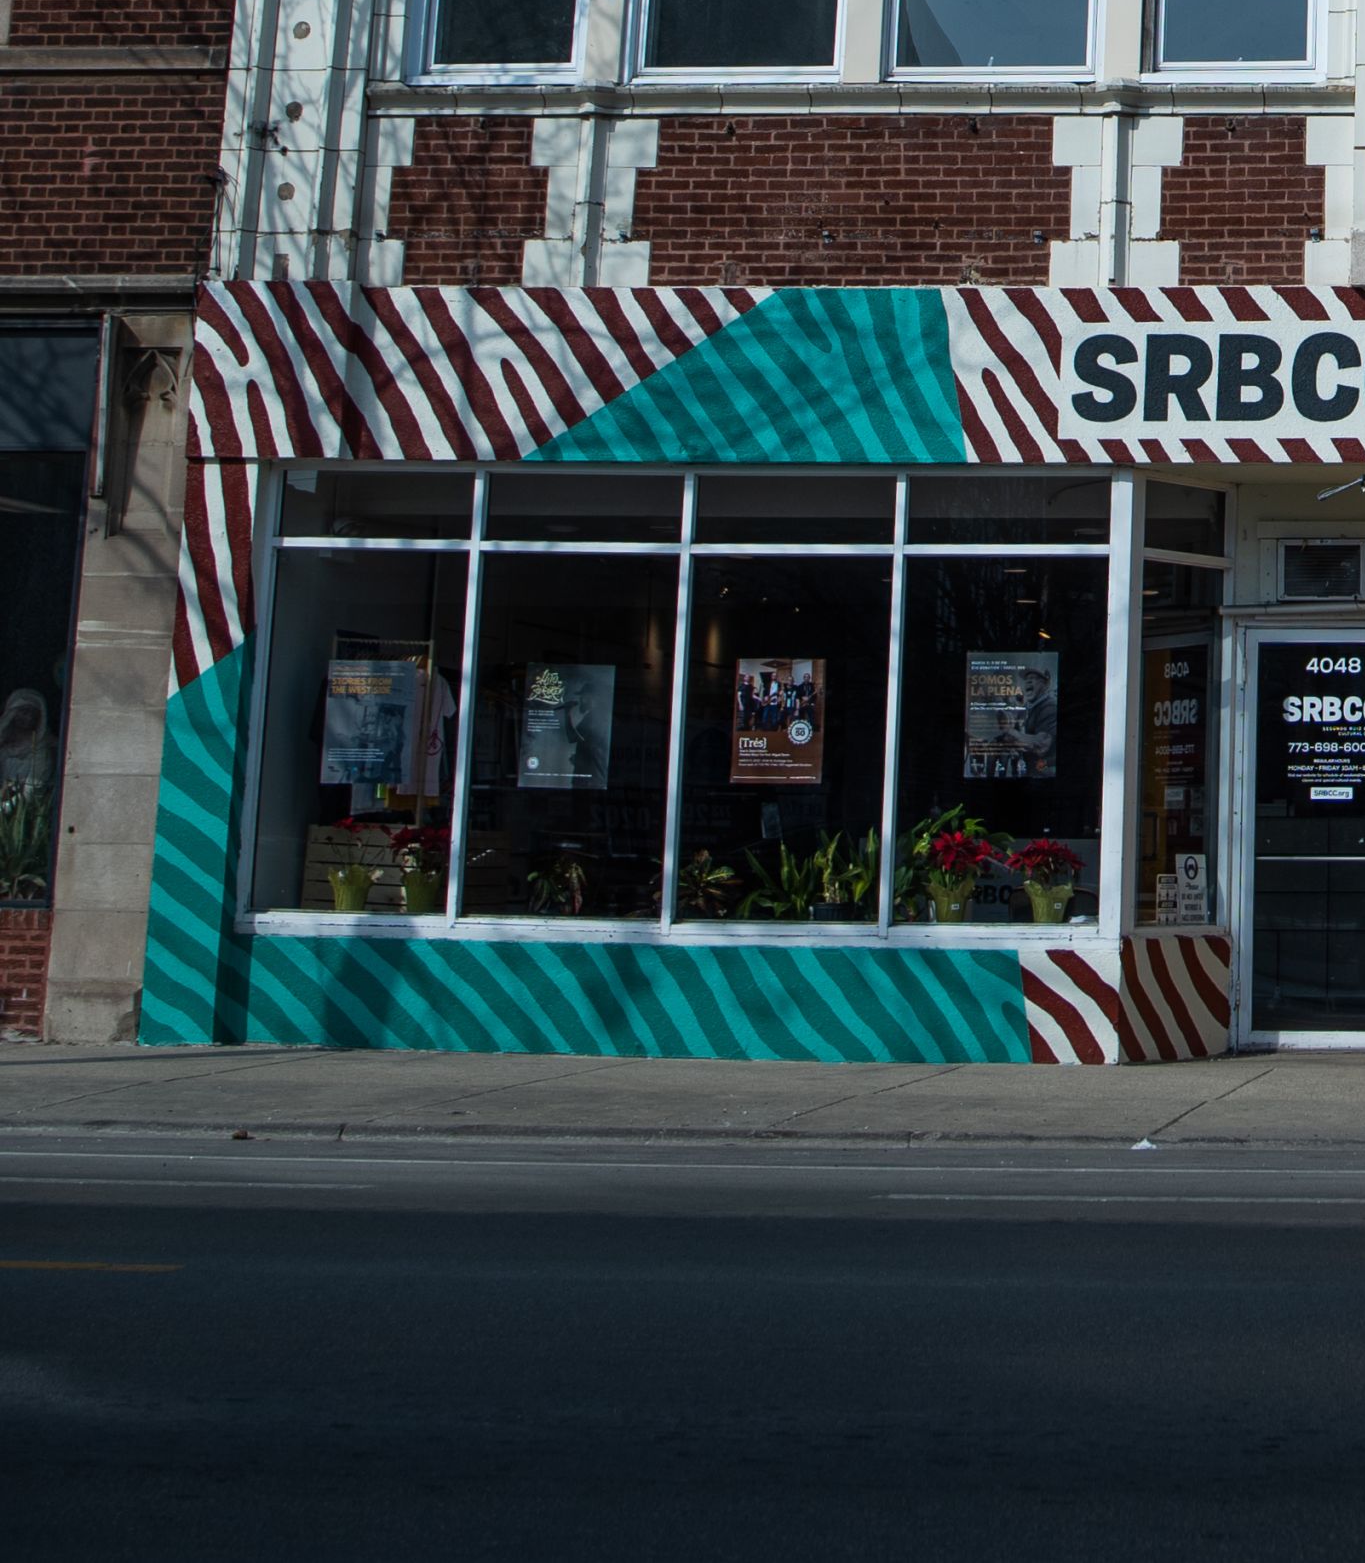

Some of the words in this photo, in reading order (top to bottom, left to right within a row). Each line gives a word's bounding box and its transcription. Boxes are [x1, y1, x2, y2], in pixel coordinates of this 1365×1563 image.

[1306, 657, 1361, 673] 4048
[332, 677, 367, 685] STORIES
[971, 674, 1013, 685] SOMOS
[348, 686, 370, 694] WEST
[971, 686, 984, 696] LA
[987, 686, 1023, 696] PLENA
[1313, 789, 1350, 798] SRBCC.org
